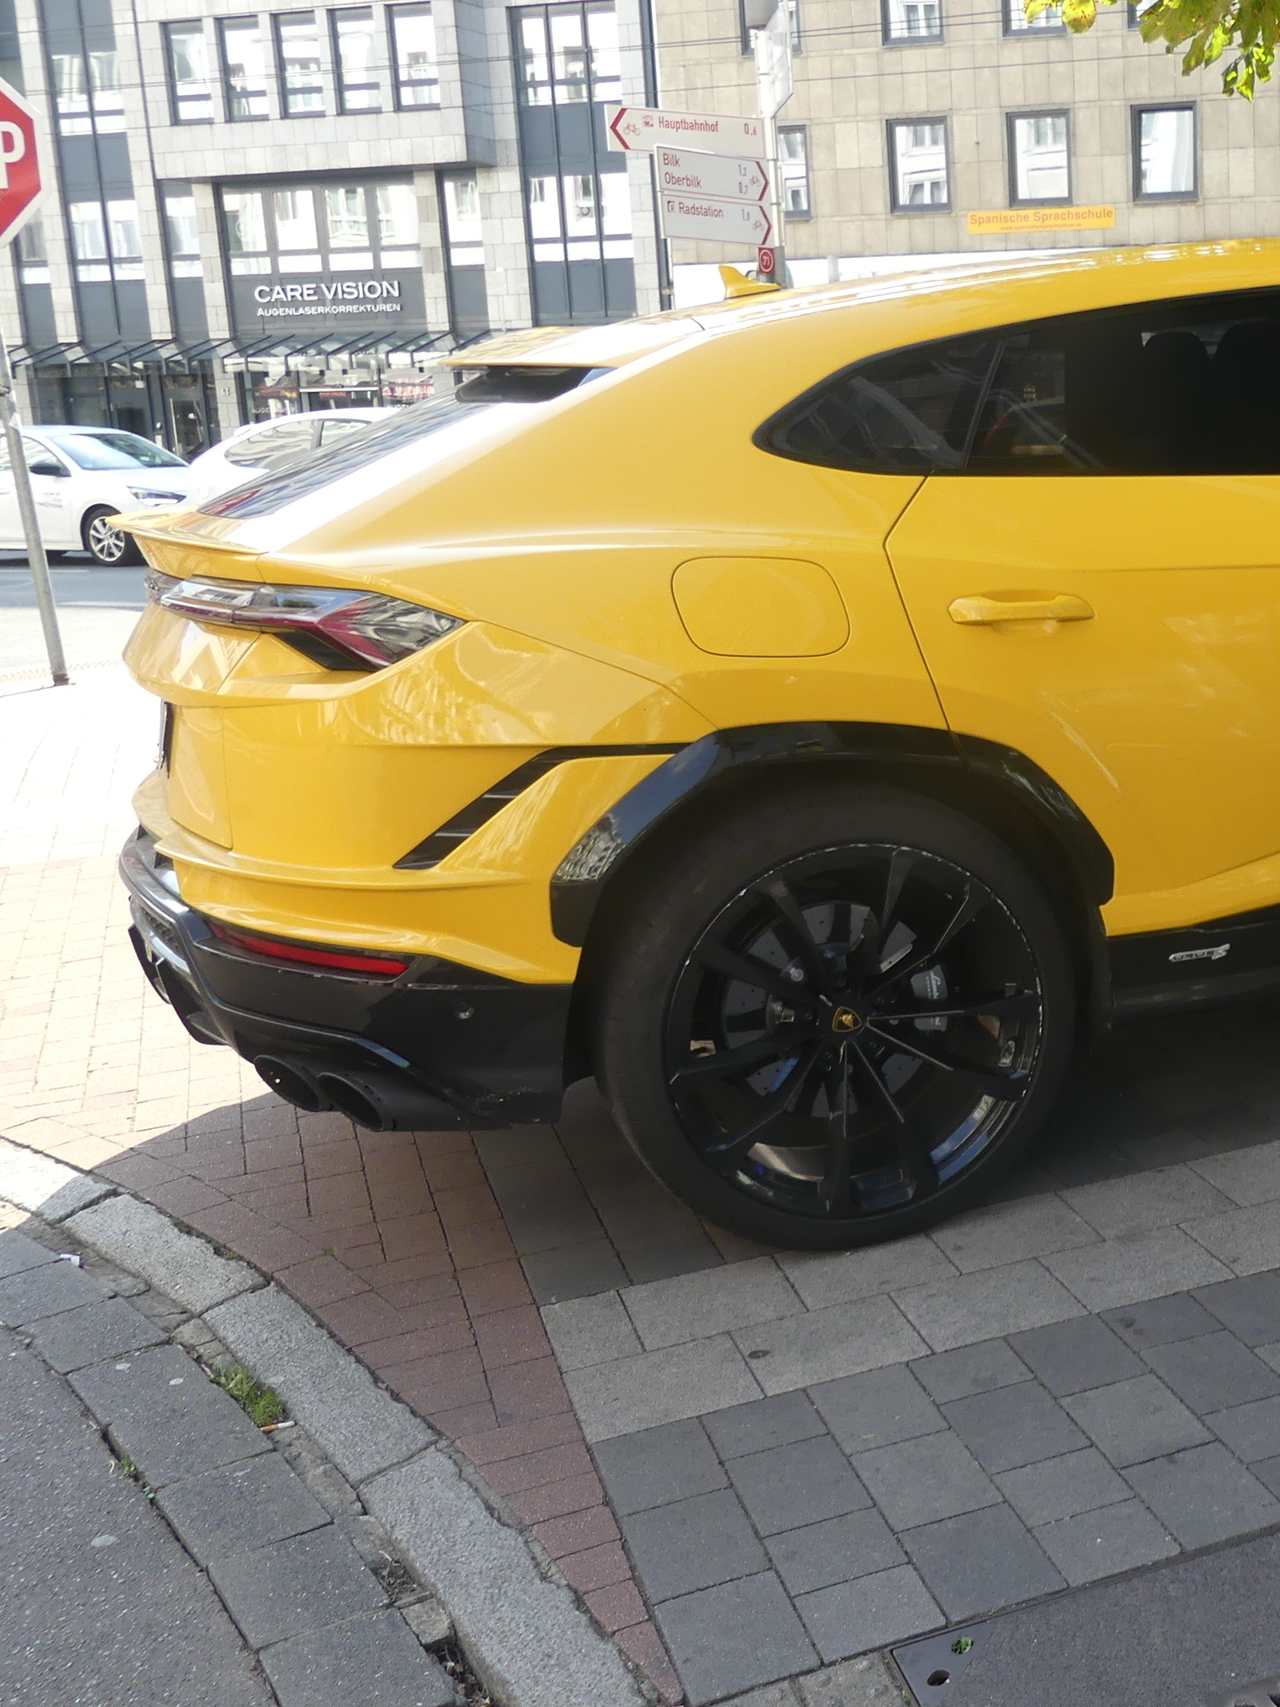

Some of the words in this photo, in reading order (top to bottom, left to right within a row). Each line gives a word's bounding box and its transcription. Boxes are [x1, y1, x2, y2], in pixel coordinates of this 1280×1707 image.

[658, 115, 720, 133] Hauptbahnhof
[663, 152, 681, 168] Bilk
[664, 171, 702, 189] Oberbilk
[678, 201, 724, 218] Radstation
[969, 212, 1030, 227] Spanische
[1033, 207, 1114, 223] Sprachschule
[254, 283, 319, 303] CARE
[319, 280, 400, 300] VISION
[256, 303, 401, 317] AUGENLASERKORREKTUREN
